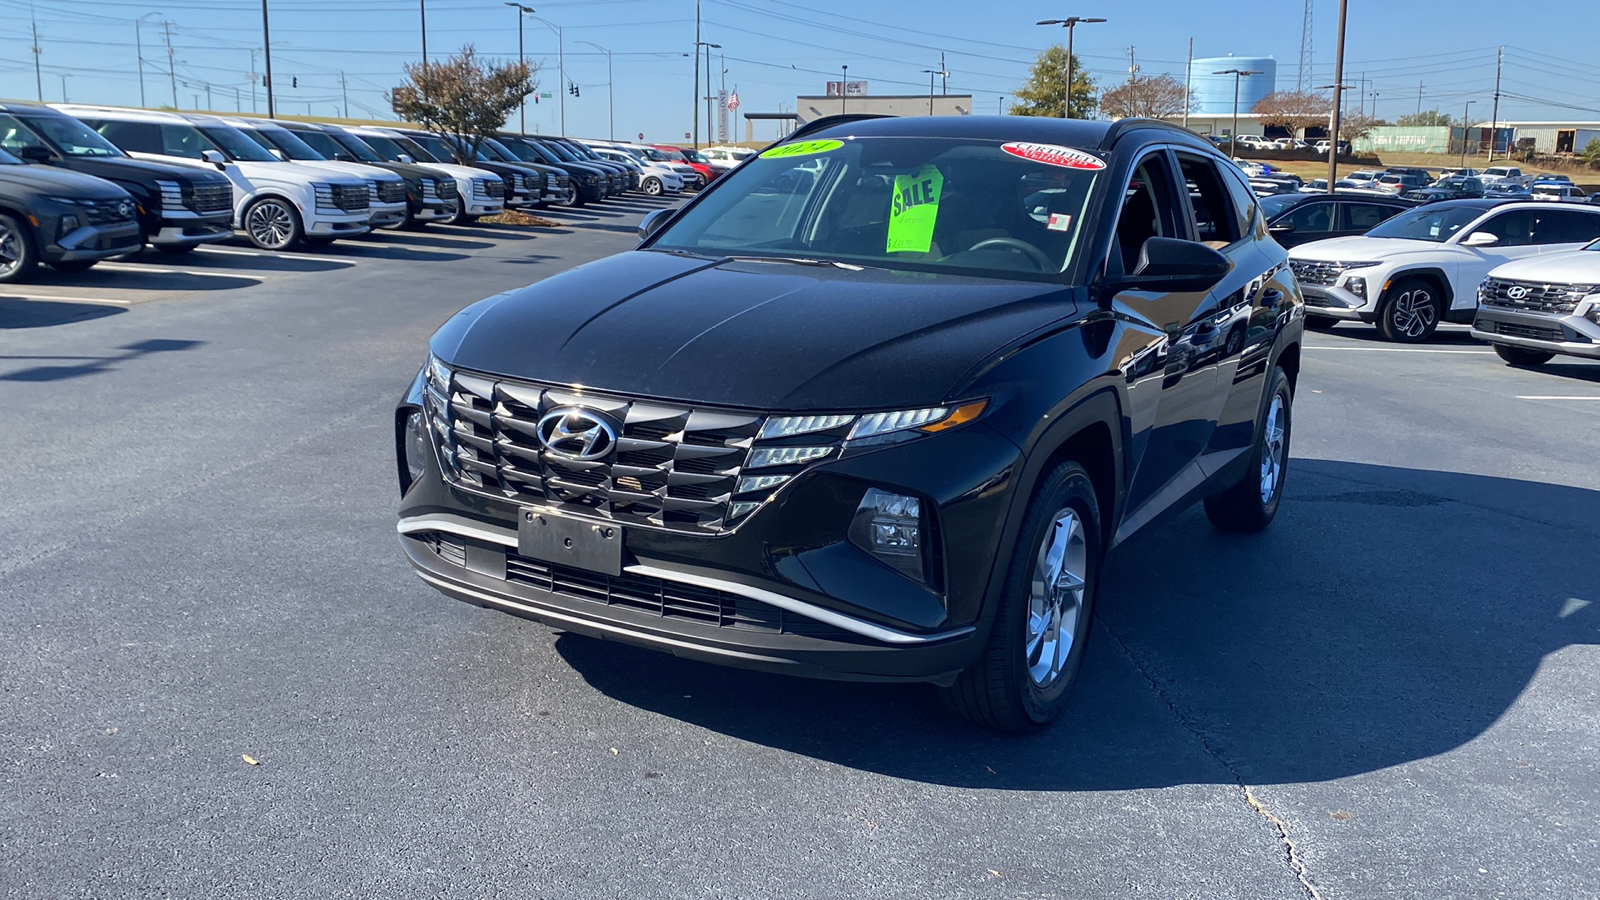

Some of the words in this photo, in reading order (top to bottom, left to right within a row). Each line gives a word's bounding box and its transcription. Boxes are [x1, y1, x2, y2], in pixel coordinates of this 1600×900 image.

[768, 141, 834, 156] 2024
[1017, 143, 1096, 163] CERTIFIED
[1025, 152, 1074, 167] VEHICLE
[893, 179, 934, 217] SALE
